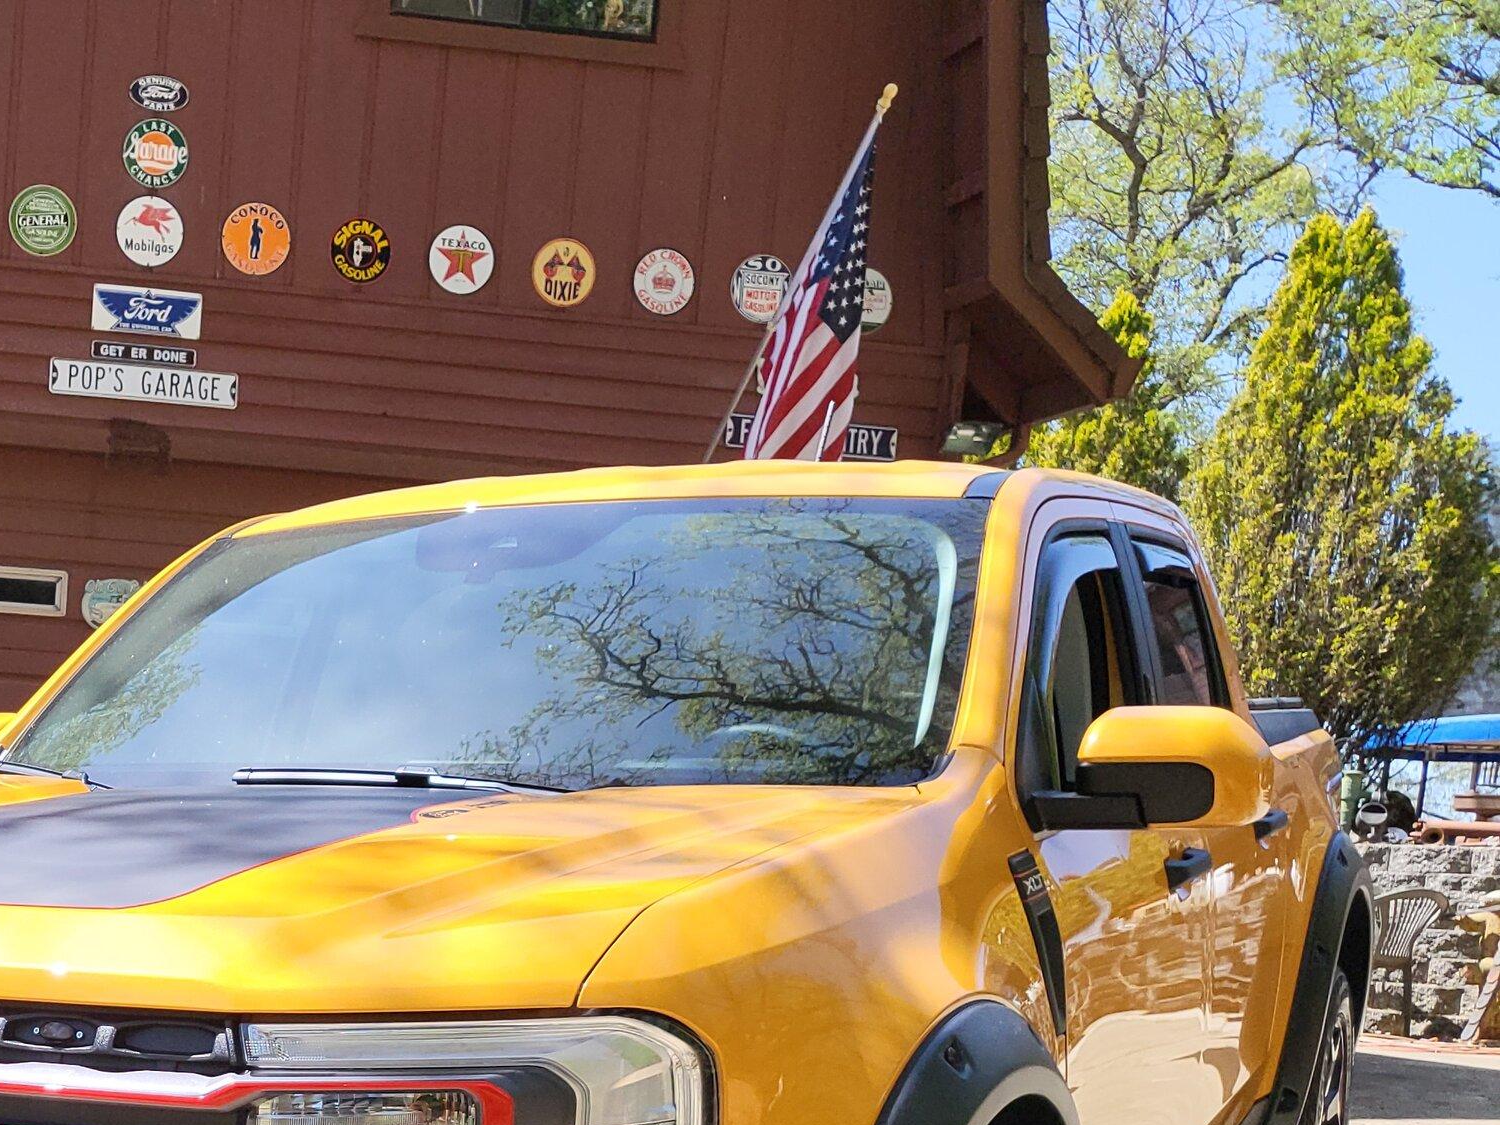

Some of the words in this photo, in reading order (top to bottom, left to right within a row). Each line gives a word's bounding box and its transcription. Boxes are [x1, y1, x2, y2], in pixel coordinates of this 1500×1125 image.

[141, 85, 178, 100] Ford
[143, 99, 176, 111] PARTS
[142, 121, 175, 135] LAST
[123, 131, 189, 170] Garage
[130, 165, 178, 187] CHANCE
[18, 214, 68, 227] GENERAL
[230, 205, 285, 230] CONOCO
[124, 238, 175, 256] Mobilgas
[334, 220, 389, 253] SIGNAL
[441, 237, 486, 251] TEXACO
[334, 254, 386, 281] GASOLINE
[637, 255, 657, 276] RED
[660, 250, 693, 279] CROWN
[544, 279, 581, 301] DIXIE
[745, 273, 780, 286] SOCONY
[637, 289, 687, 314] GASOLINE
[745, 290, 778, 301] MOTOR
[123, 297, 173, 323] Ford
[99, 343, 125, 359] GET
[131, 347, 148, 360] ER
[153, 349, 188, 364] DONE
[68, 364, 124, 393] POP'S
[141, 371, 221, 402] GARAGE
